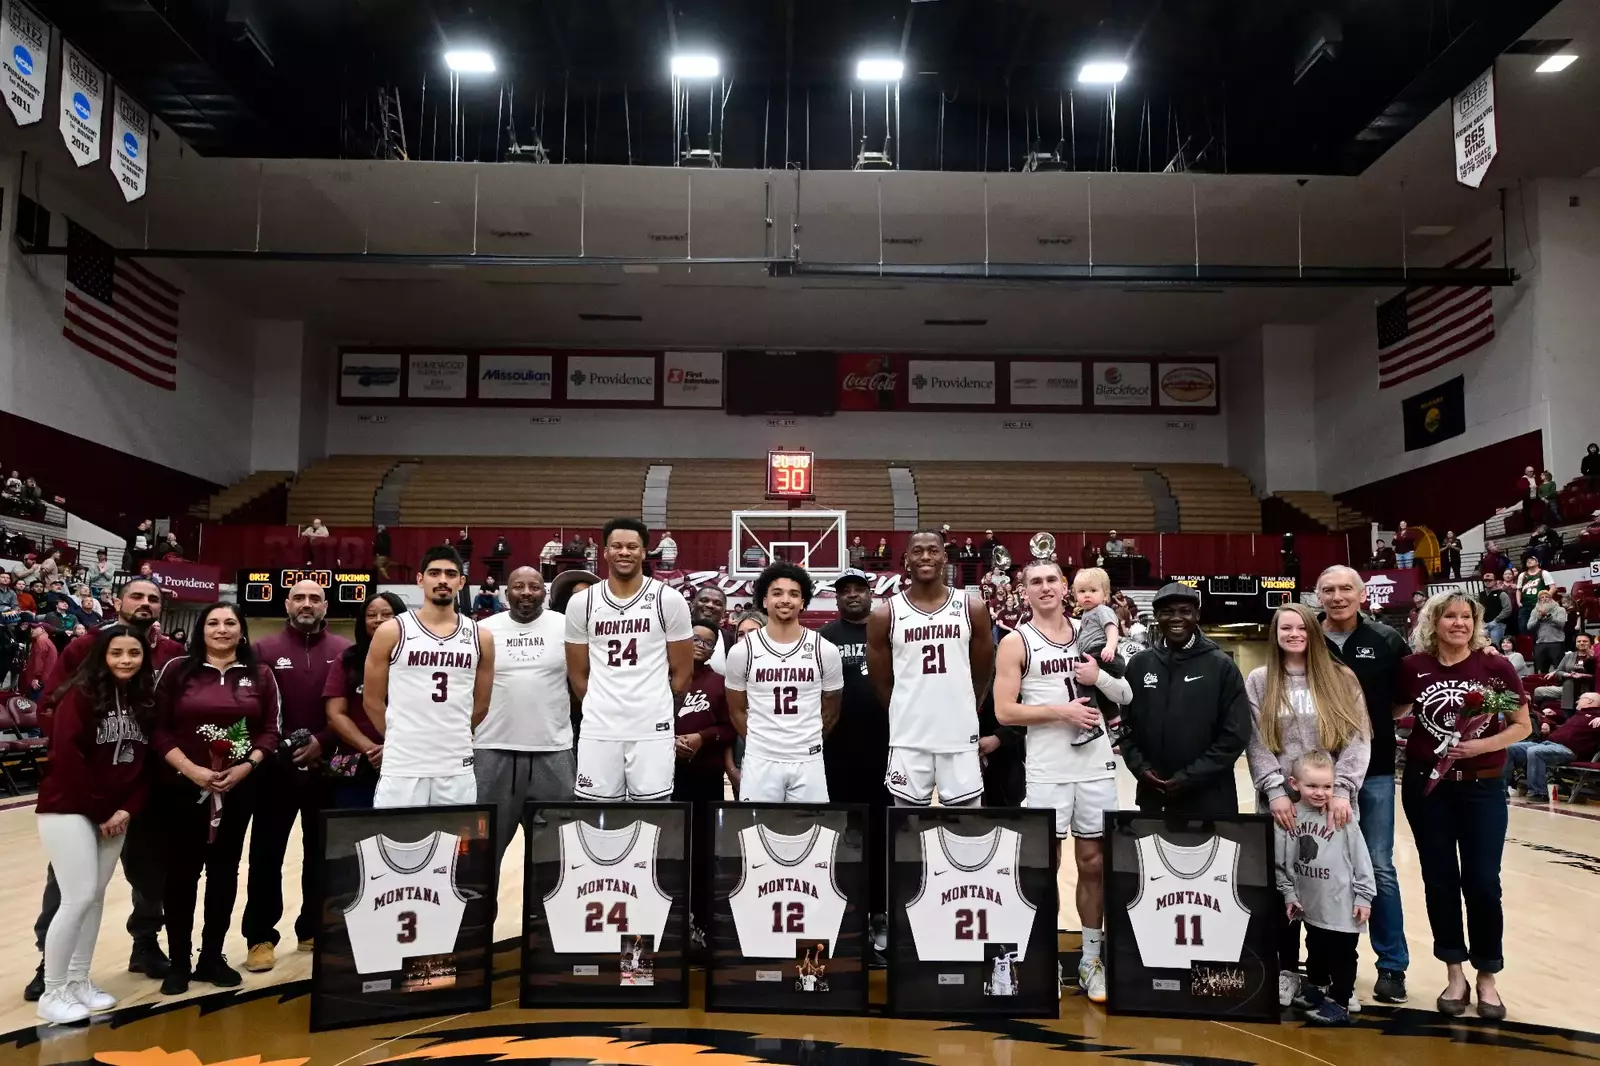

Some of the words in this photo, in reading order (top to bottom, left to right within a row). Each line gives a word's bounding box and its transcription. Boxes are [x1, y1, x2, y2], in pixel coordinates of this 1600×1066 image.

[70, 57, 98, 93] GRIZ
[11, 91, 31, 114] 2011
[1456, 122, 1473, 139] ROBIN
[1473, 105, 1493, 126] SELVIG
[71, 135, 90, 155] 2013
[1465, 123, 1485, 149] 865
[1464, 138, 1486, 159] WINS
[122, 173, 138, 191] 2015
[481, 369, 550, 382] Missoulian
[589, 372, 653, 386] Providence
[931, 376, 993, 389] Providence
[1096, 384, 1150, 396] Blackfoot
[777, 468, 805, 490] 30
[164, 575, 215, 589] Providence
[335, 574, 370, 582] VIKINGS
[1261, 581, 1296, 589] VIKINGS
[262, 585, 271, 600] 0
[355, 586, 365, 601] 0
[1367, 594, 1390, 604] Hut
[595, 618, 650, 636] MONTANA
[904, 624, 961, 644] MONTANA
[506, 637, 545, 647] MONTANA
[607, 638, 638, 667] 24
[837, 643, 867, 658] GRIZ
[408, 650, 472, 669] MONTANA
[922, 644, 947, 674] 21
[1040, 656, 1079, 676] MONT
[755, 667, 814, 682] MONTANA
[431, 671, 448, 703] 3
[678, 690, 710, 718] riz
[772, 686, 799, 715] 12
[1288, 821, 1335, 842] MONTANA
[373, 886, 441, 911] MONTANA
[577, 878, 638, 899] MONTANA
[758, 878, 819, 899] MONTANA
[941, 884, 1002, 906] MONTANA
[1156, 890, 1221, 913] MONTANA
[396, 910, 417, 944] 3
[584, 901, 629, 933] 24
[772, 901, 805, 934] 12
[954, 908, 989, 940] 21
[1174, 914, 1204, 946] 11
